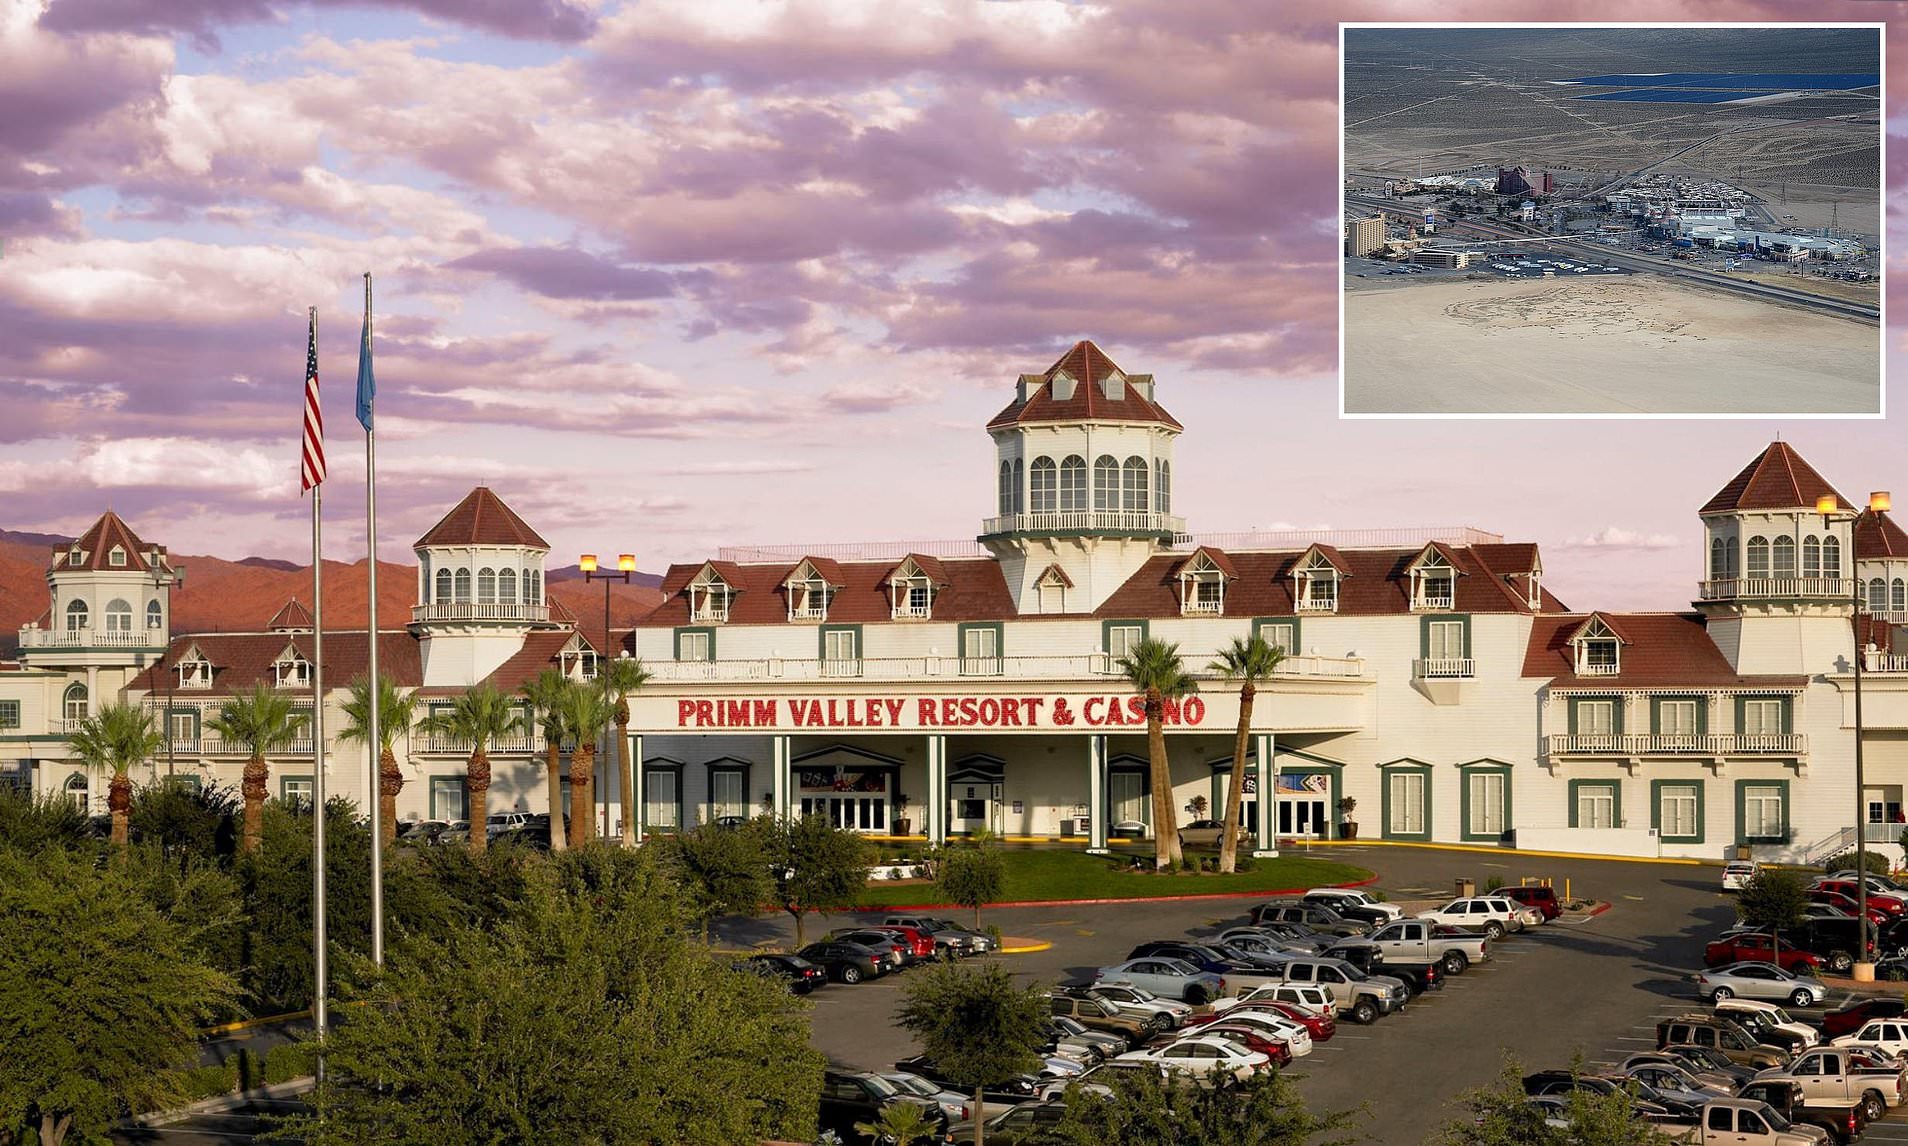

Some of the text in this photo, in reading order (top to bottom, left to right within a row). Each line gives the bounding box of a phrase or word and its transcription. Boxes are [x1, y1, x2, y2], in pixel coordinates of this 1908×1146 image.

[678, 696, 1205, 727] PRIMM VALLEY RESORT & CASNO
